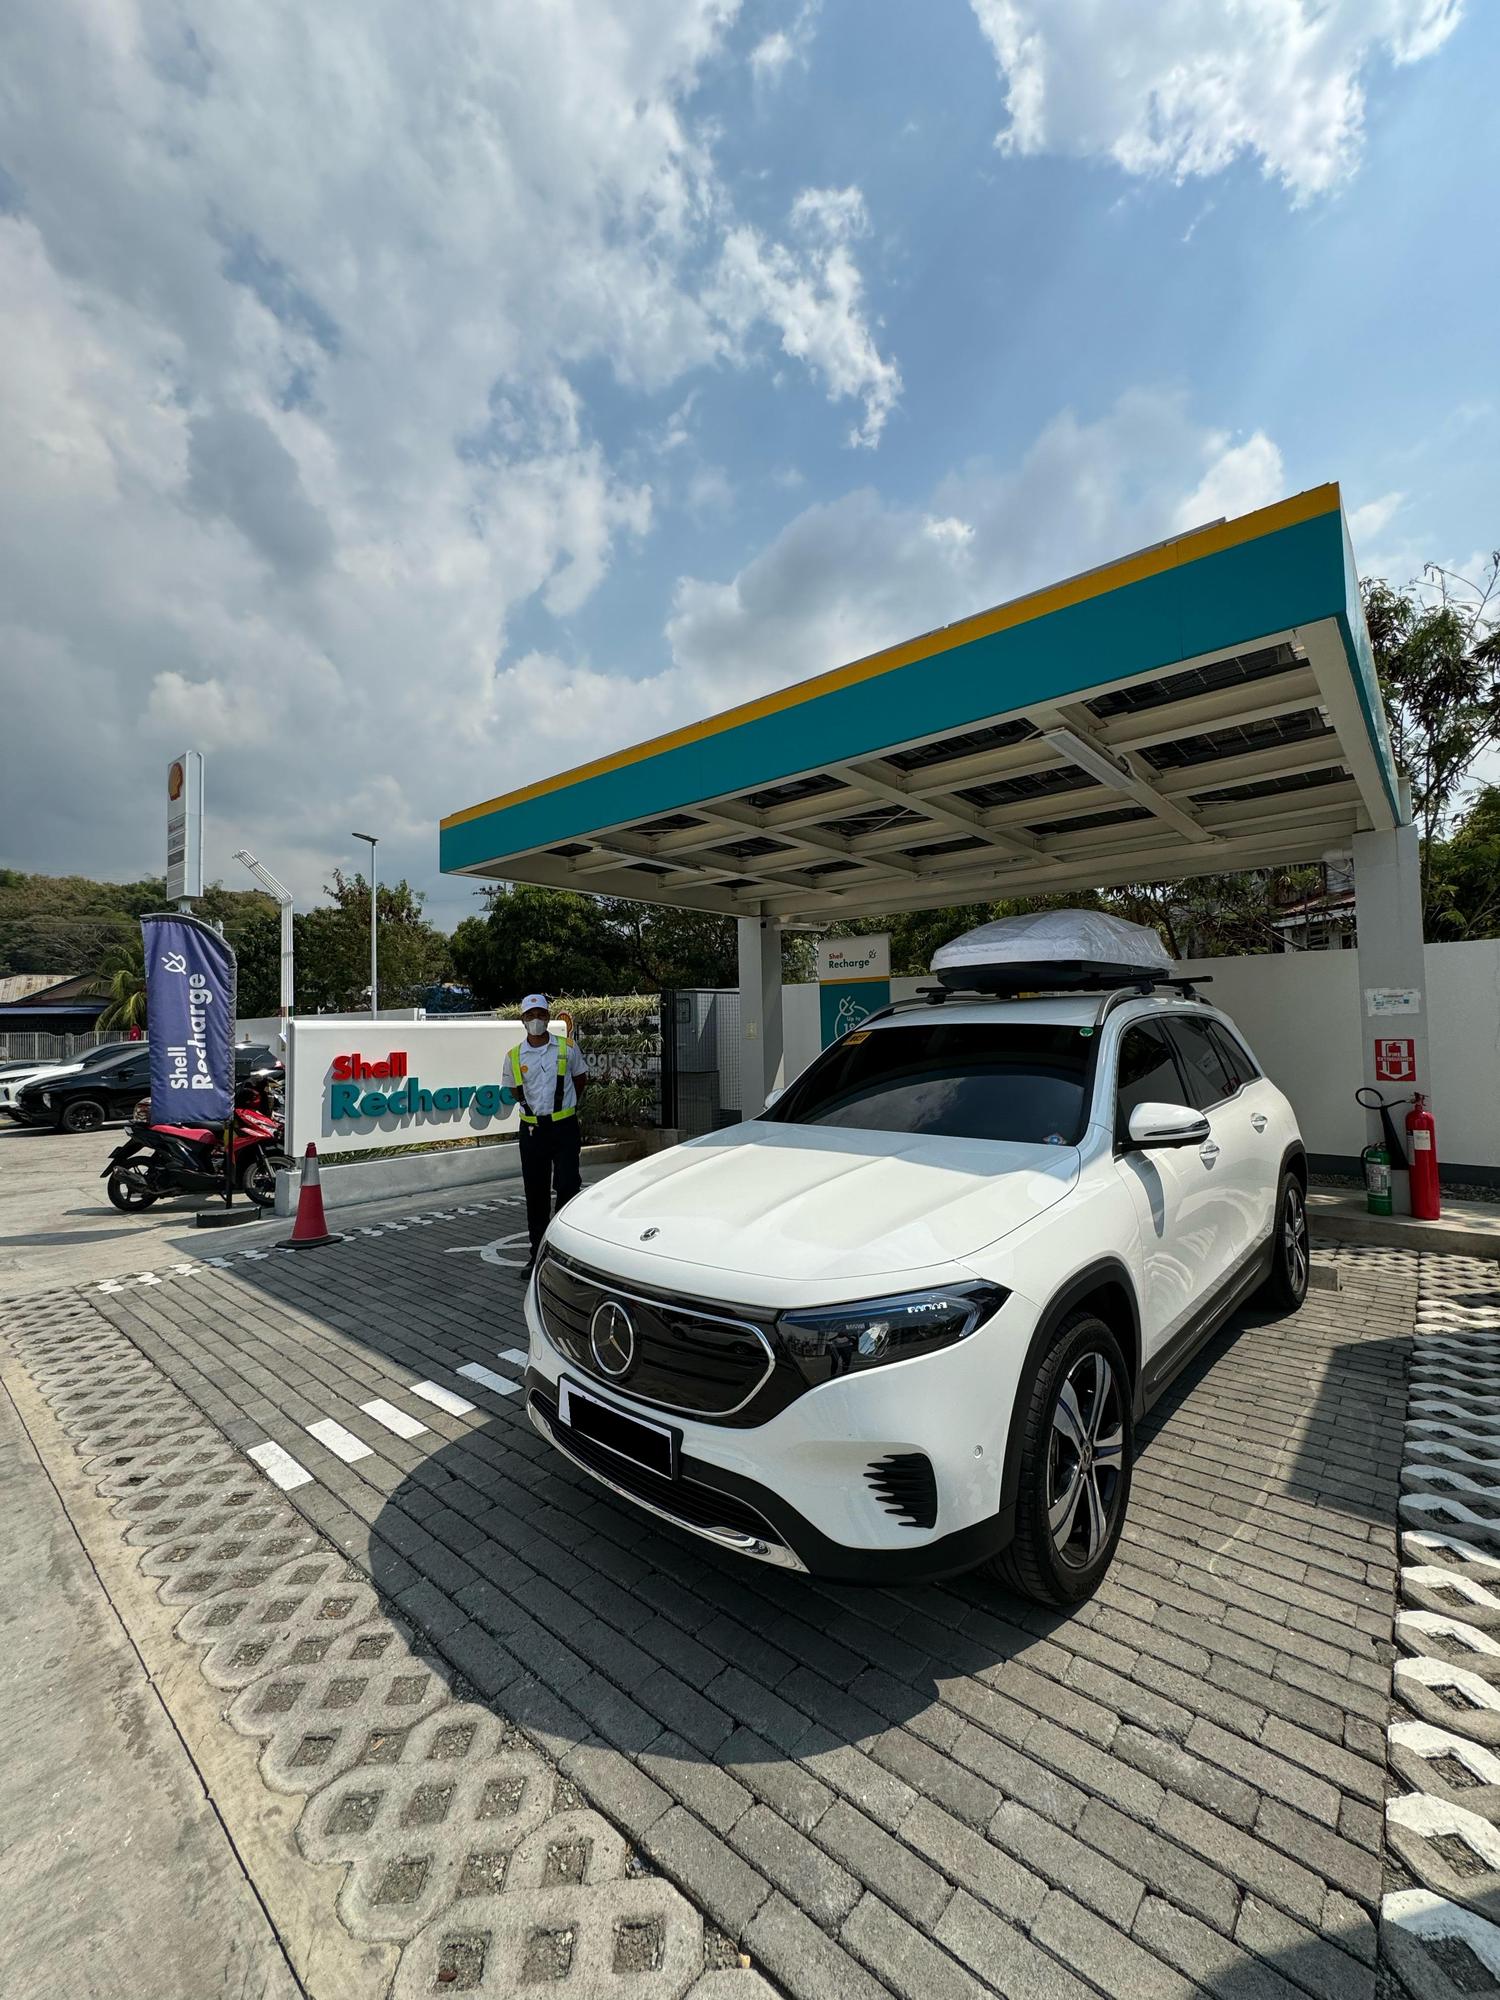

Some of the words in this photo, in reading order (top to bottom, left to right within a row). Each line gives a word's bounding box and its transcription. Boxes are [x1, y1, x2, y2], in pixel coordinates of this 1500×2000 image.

[829, 959, 870, 969] Recharge
[187, 973, 214, 1090] Recharge
[167, 1046, 189, 1089] Shell
[331, 1051, 408, 1081] Shell
[583, 1053, 643, 1072] ogress
[331, 1077, 519, 1120] Recharge
